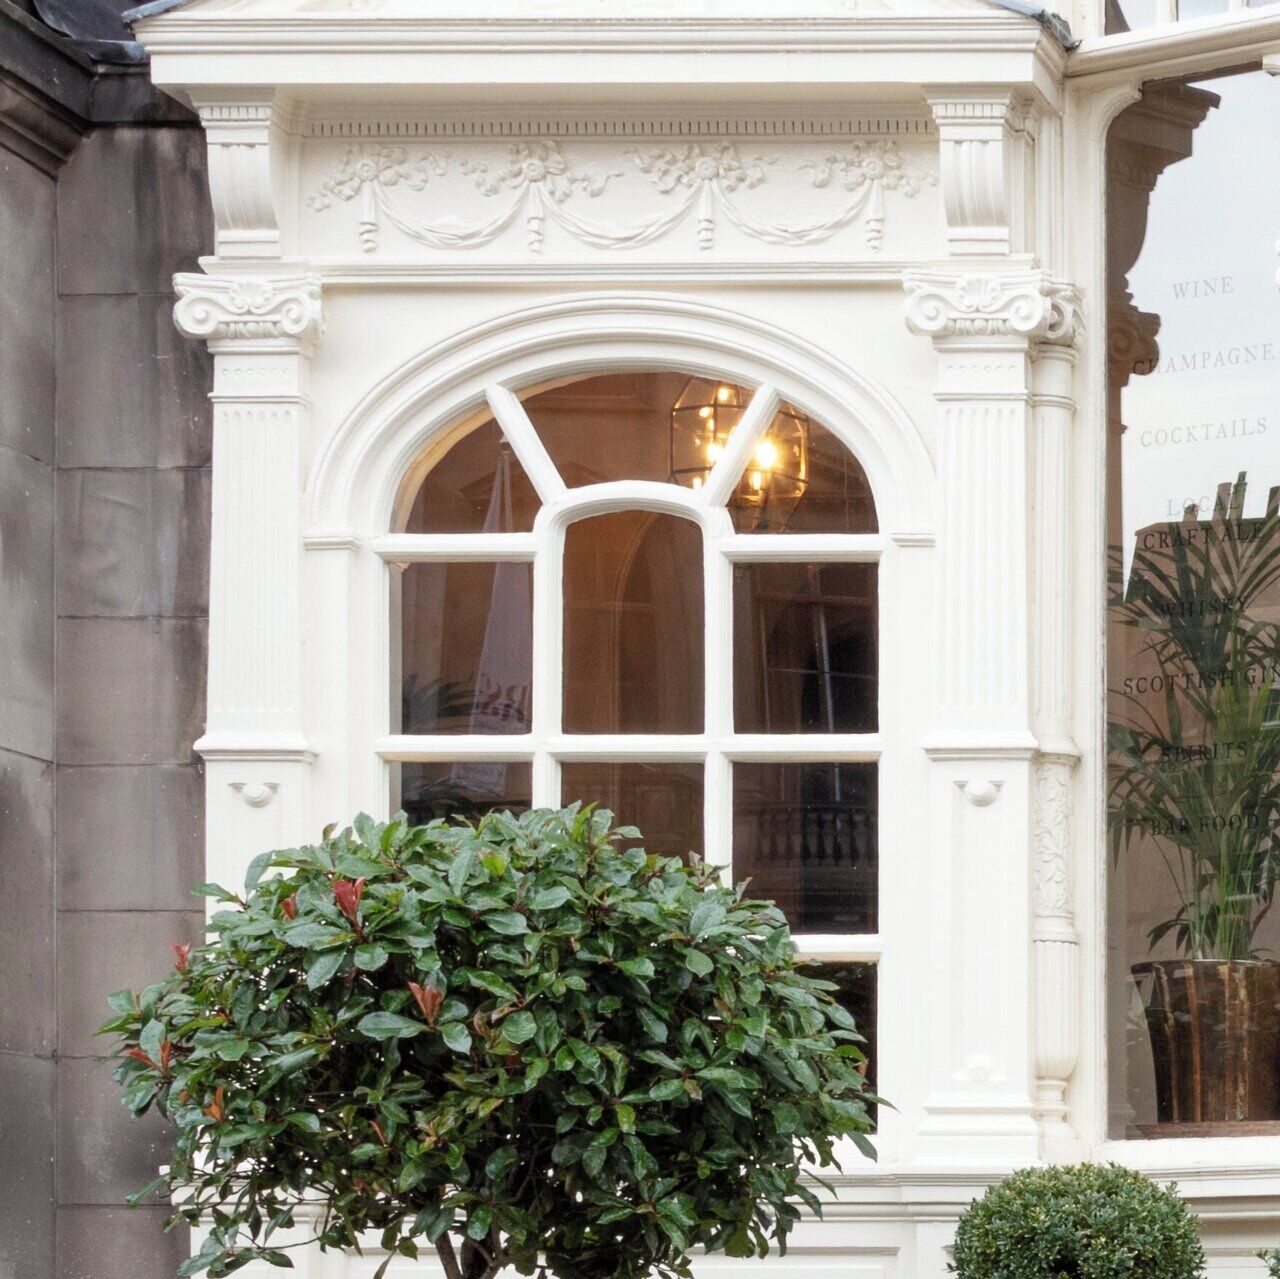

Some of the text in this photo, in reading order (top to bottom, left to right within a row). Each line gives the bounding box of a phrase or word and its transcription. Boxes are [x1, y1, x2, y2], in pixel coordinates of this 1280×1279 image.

[1172, 276, 1234, 300] WINE
[1132, 343, 1275, 375] CHAMPAGNE
[1140, 417, 1267, 447] COCKTAILS
[1166, 490, 1241, 517] LOCAL
[1143, 522, 1264, 550] CRAFT ALE
[1158, 597, 1246, 619] WHISKY
[1124, 669, 1234, 696] SCOTTISH
[1162, 741, 1249, 763] SPIRITS
[1152, 814, 1259, 836] BAR FOOD
